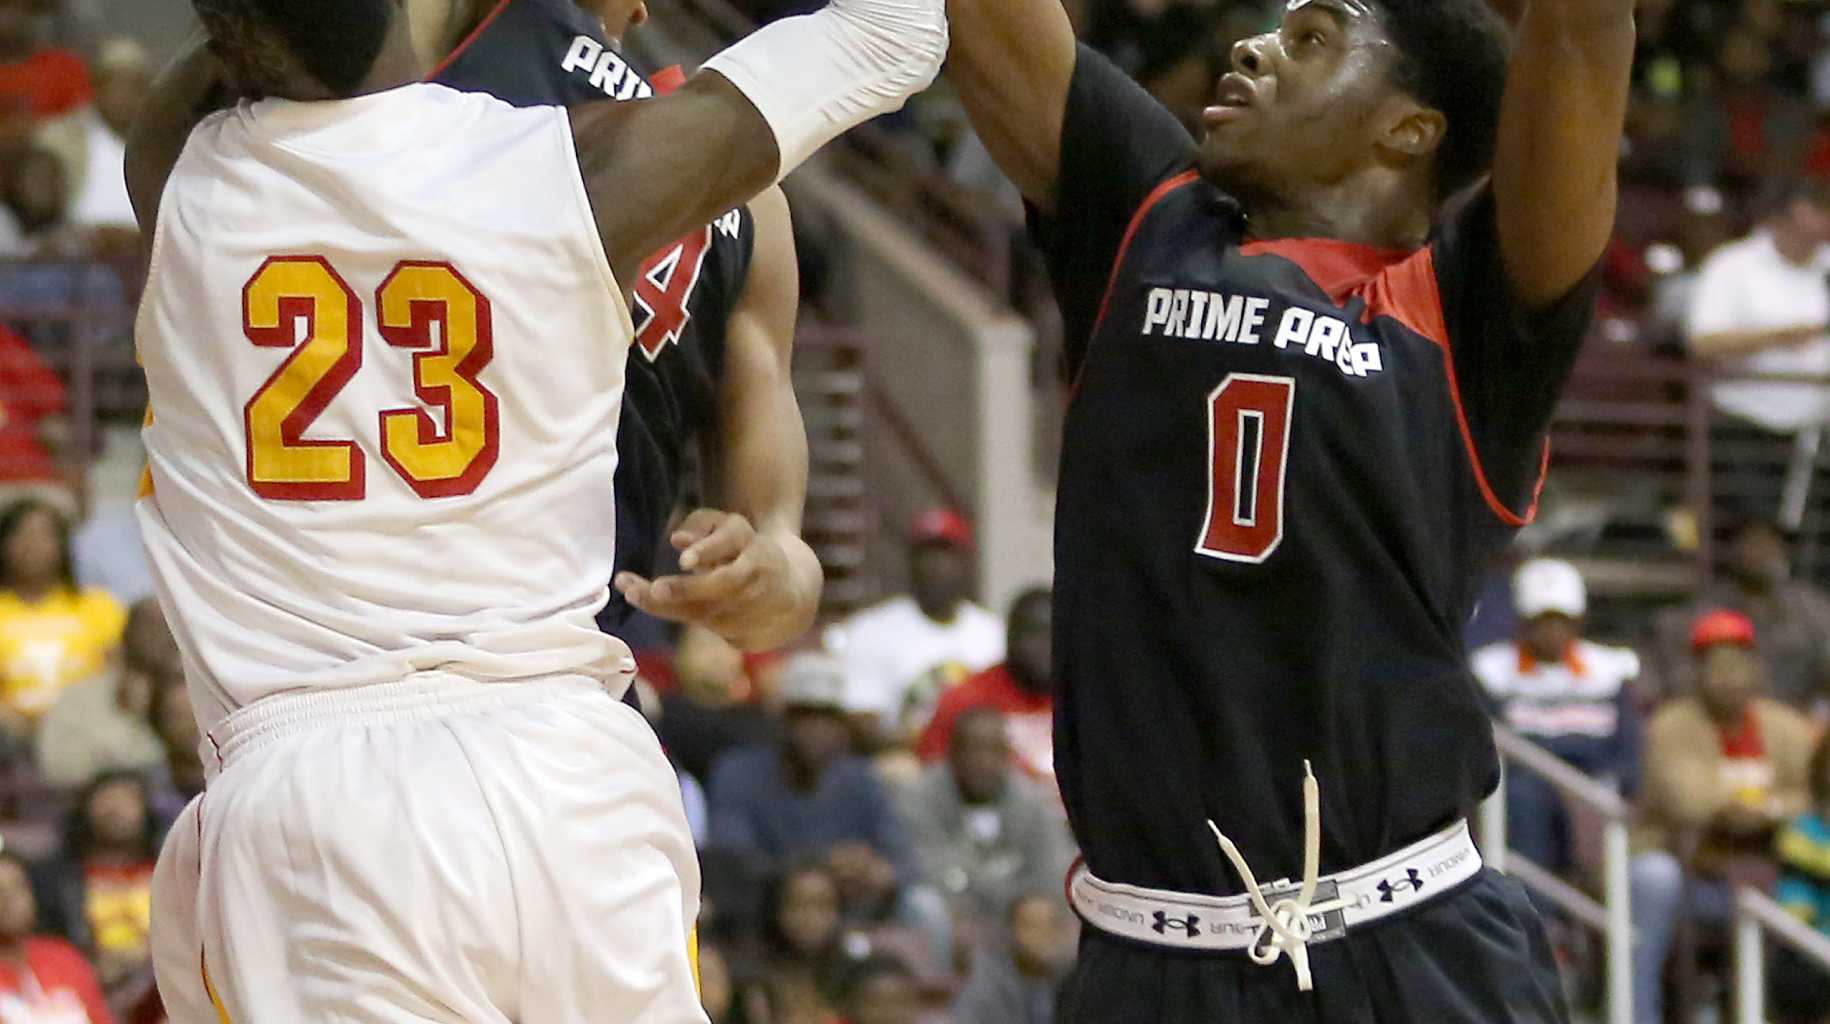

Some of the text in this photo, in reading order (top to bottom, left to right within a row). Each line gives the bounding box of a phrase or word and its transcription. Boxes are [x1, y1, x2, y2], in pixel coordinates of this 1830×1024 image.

[634, 223, 712, 363] 4
[1143, 287, 1383, 377] PRIME PREP
[242, 255, 500, 500] 23
[1194, 372, 1296, 564] 0
